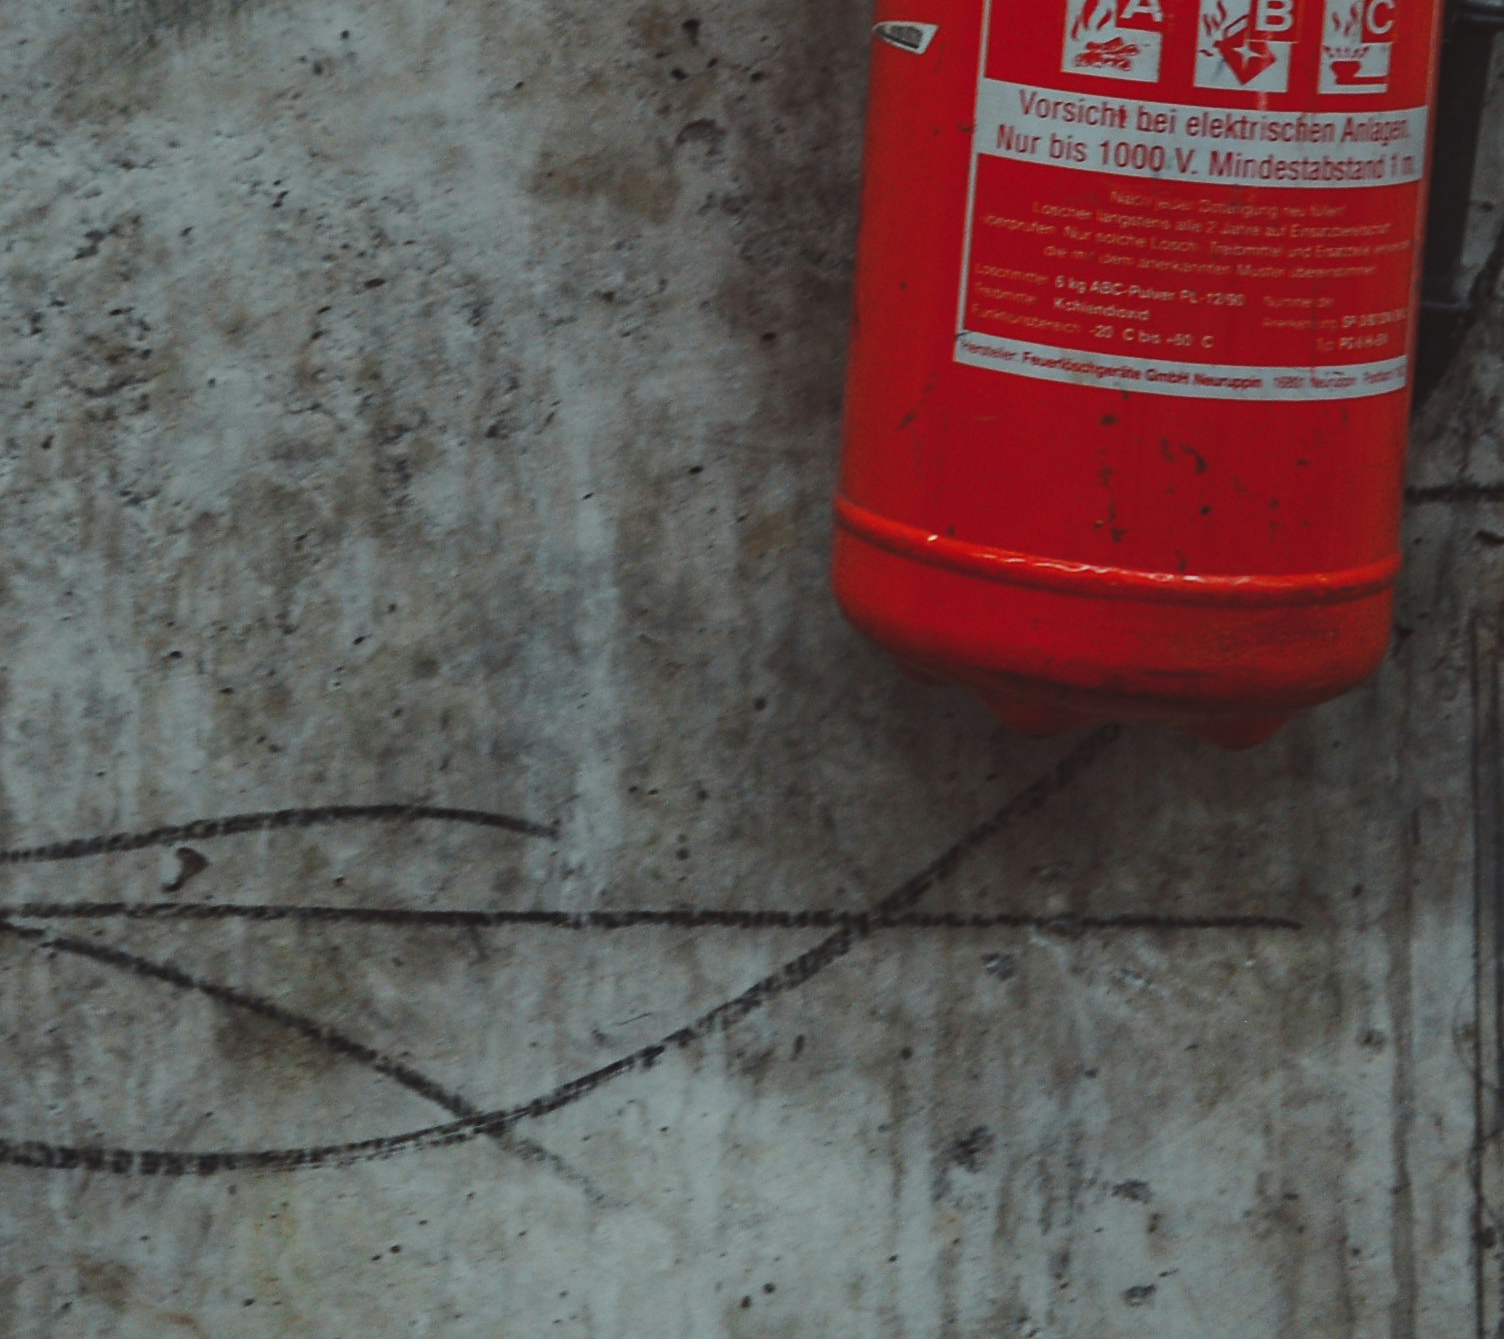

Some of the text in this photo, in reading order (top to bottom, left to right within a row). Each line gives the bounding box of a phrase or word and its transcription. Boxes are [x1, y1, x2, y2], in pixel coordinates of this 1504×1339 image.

[1019, 89, 1128, 129] Vorsicht
[1136, 104, 1176, 135] bei
[1185, 111, 1336, 143] elektrischen
[995, 123, 1040, 154] Nur
[1049, 133, 1088, 164] bis
[1100, 139, 1166, 172] 1000
[1175, 146, 1198, 175] V.
[1207, 148, 1385, 182] Mindestabstand
